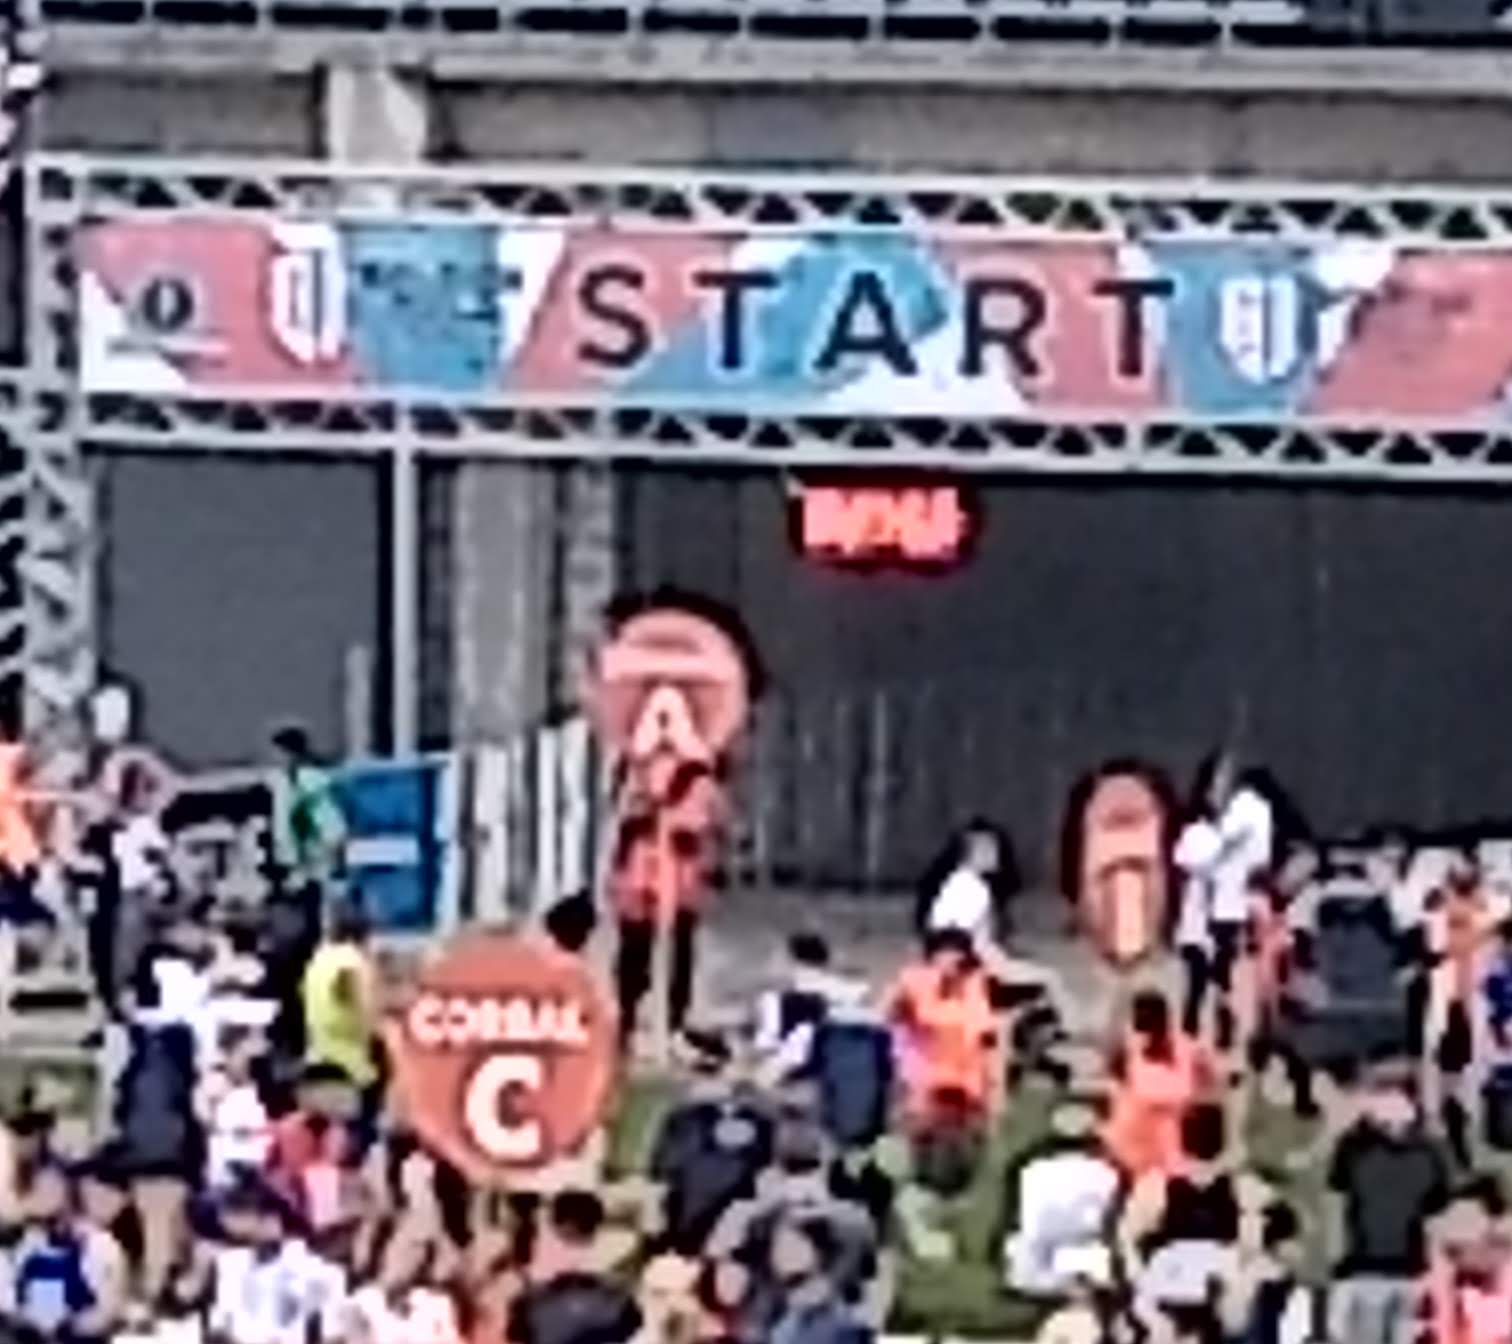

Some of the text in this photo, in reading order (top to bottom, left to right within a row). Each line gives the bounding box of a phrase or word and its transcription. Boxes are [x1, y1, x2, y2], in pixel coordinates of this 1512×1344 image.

[577, 264, 1175, 379] START
[632, 683, 711, 759] A
[464, 1052, 545, 1161] C
